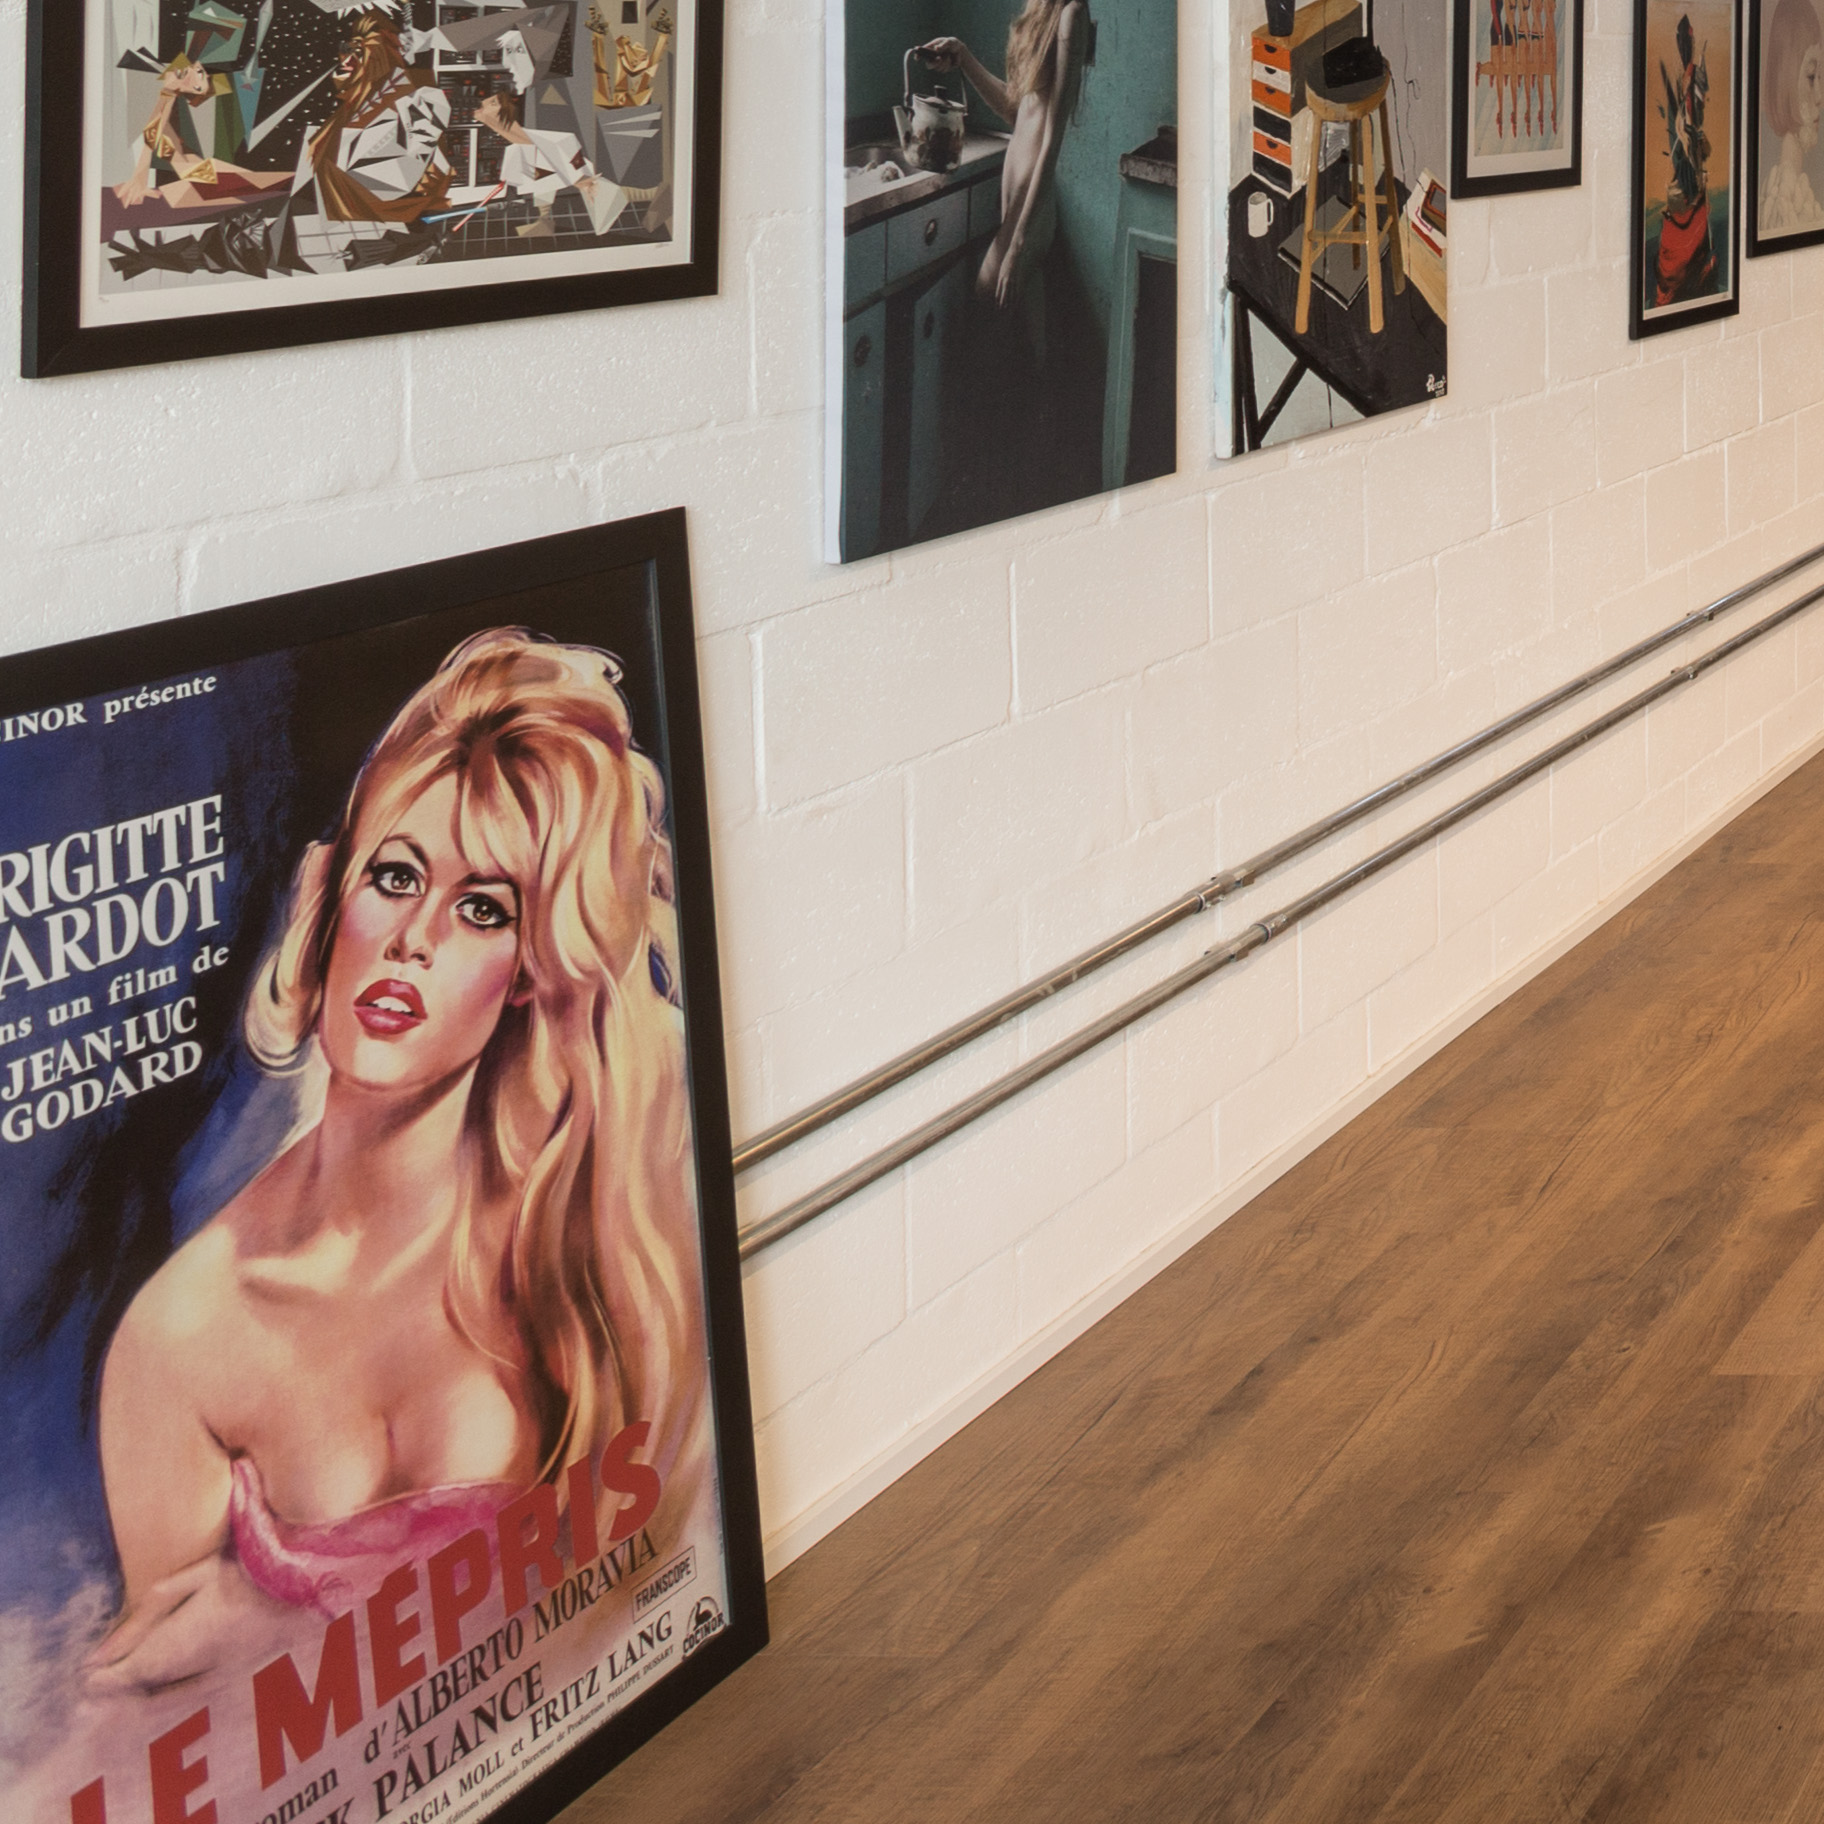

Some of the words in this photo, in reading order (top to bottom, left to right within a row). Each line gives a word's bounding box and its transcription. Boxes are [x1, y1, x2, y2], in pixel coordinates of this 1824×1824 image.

[0, 701, 87, 743] INOR
[104, 675, 217, 723] présente
[48, 995, 93, 1028] un
[108, 966, 177, 1006] film
[192, 944, 230, 974] de
[1, 1041, 203, 1143] GODARD
[2, 997, 198, 1101] JEAN-LUC
[252, 1421, 662, 1791] MÉPRIS
[635, 1556, 692, 1612] FRANSCOPE
[682, 1613, 728, 1654] COCINOR
[364, 1617, 525, 1764] d'ALBERTO
[532, 1528, 658, 1643] MORAVIA
[373, 1661, 545, 1824] PALANCE
[458, 1750, 505, 1798] MOLL
[510, 1736, 524, 1757] et
[530, 1665, 600, 1742] FRITZ
[607, 1610, 674, 1682] LANG
[567, 1701, 605, 1734] Production
